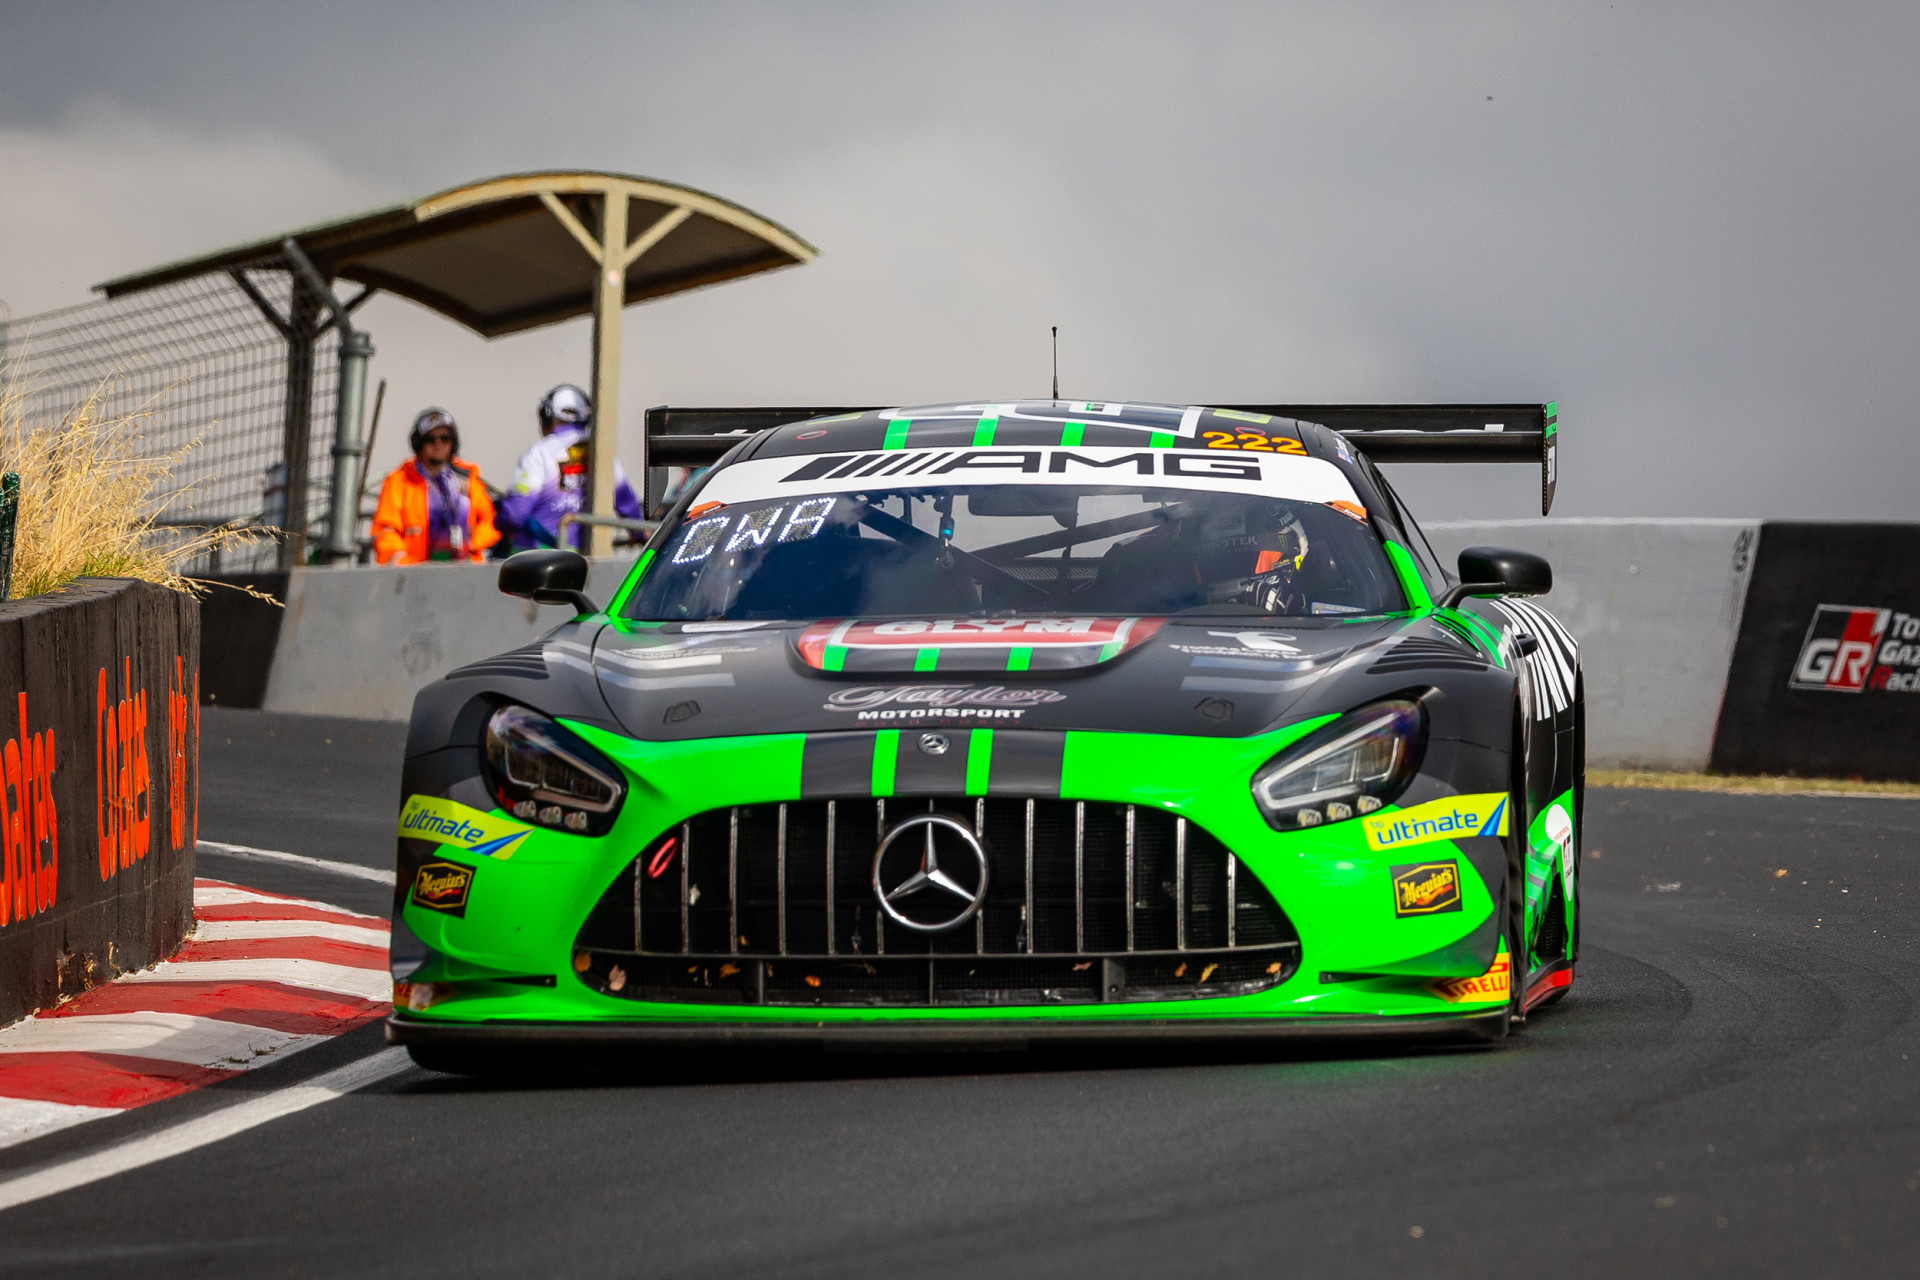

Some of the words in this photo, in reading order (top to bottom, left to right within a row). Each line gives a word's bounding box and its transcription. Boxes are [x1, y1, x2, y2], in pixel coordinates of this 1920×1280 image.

[1203, 431, 1308, 456] 222
[928, 451, 1262, 481] AMG
[672, 496, 837, 565] CWA
[874, 619, 1095, 635] GLYM
[1797, 638, 1873, 684] GR
[823, 684, 1067, 711] Taylor
[857, 708, 1026, 720] MOTORSPORT
[97, 656, 150, 882] Coates
[403, 808, 484, 843] ultimate
[1370, 821, 1385, 830] bp
[1377, 809, 1479, 845] ultimate
[418, 871, 466, 896] Meguiar's
[1400, 867, 1454, 907] Meguiar's
[1433, 975, 1509, 998] PIRELLI
